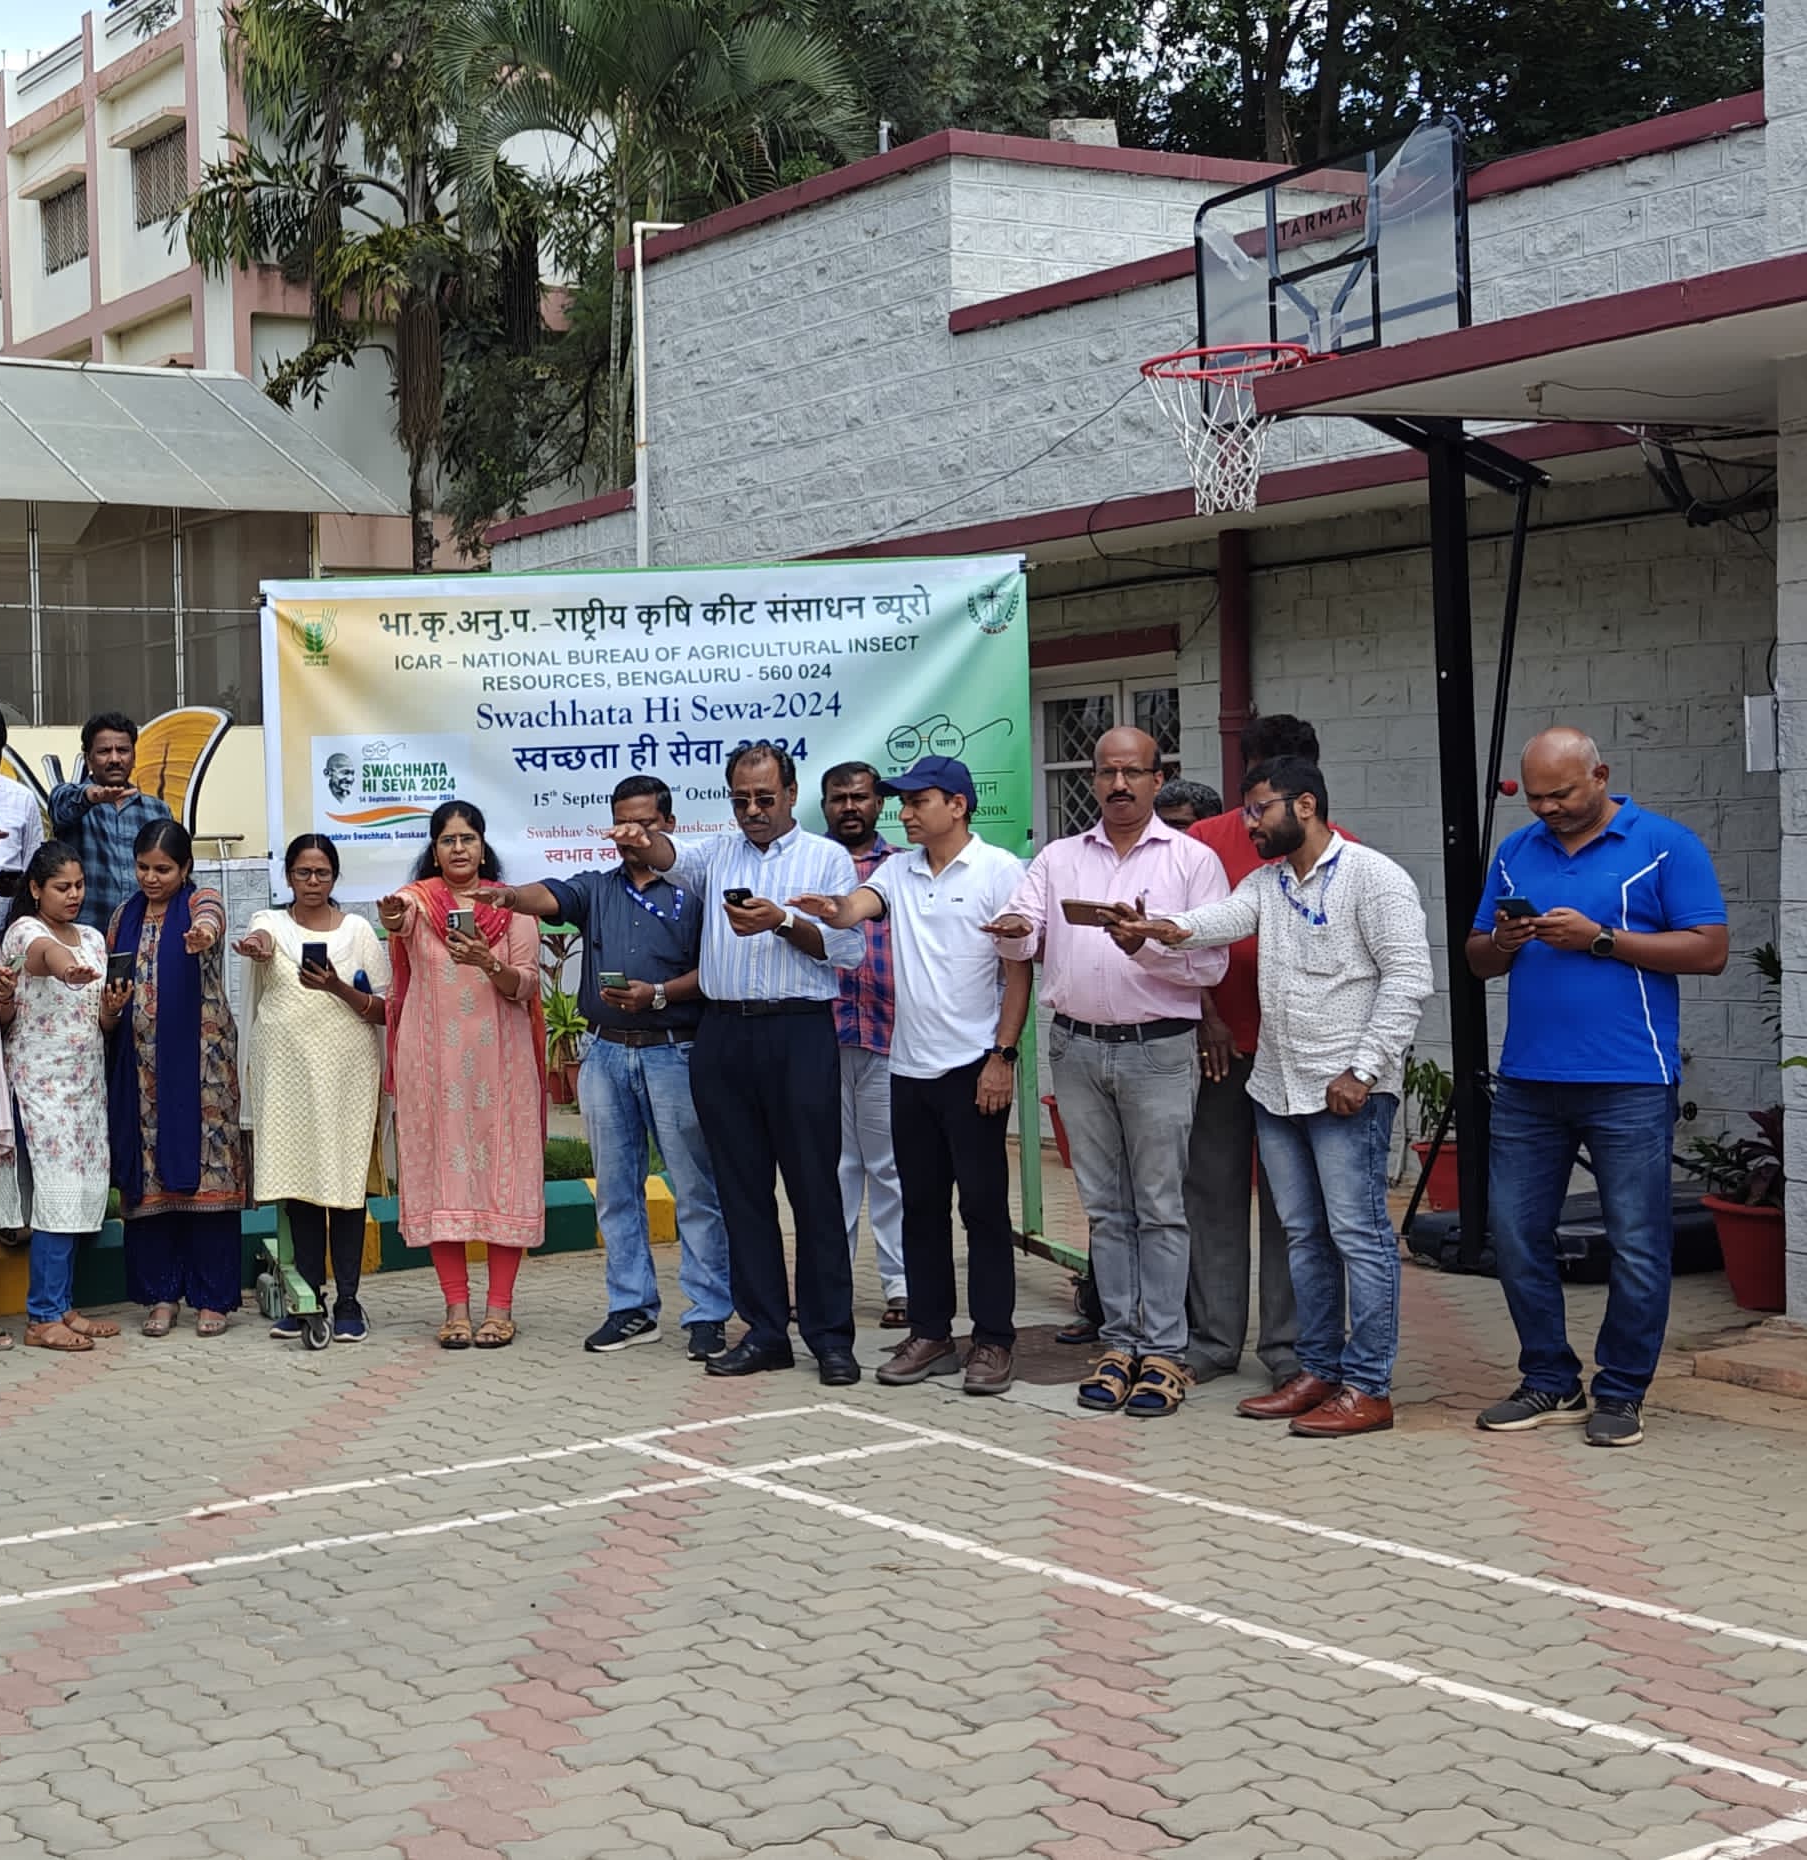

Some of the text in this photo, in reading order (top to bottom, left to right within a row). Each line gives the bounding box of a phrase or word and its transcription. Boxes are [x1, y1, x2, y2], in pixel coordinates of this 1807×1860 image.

[1278, 195, 1362, 240] TARMAK
[636, 594, 693, 635] कृषि
[701, 592, 757, 626] कीट
[766, 592, 865, 624] संसाधन
[873, 584, 932, 624] ब्यूरो
[394, 654, 442, 671] ICAR
[462, 651, 561, 669] NATIONAL
[567, 648, 649, 666] BUREAU
[656, 646, 681, 661] OF
[687, 639, 842, 661] AGRICULTURAL
[848, 635, 920, 654] INSECT
[482, 672, 611, 692] RESOURCES,
[617, 666, 740, 688] BENGALURU
[759, 664, 793, 682] 560
[798, 662, 832, 680] 024
[476, 690, 843, 730] Swachhata Hi Sewa-2024
[513, 743, 620, 773] स्वच्छता
[628, 733, 659, 771] ही
[362, 761, 448, 778] SWACHHATA
[362, 777, 456, 793] HI SEVA 2024
[975, 804, 1008, 817] SSION
[527, 826, 583, 840] Swabhav
[674, 819, 725, 834] anskaar
[545, 847, 593, 864] स्वभाव
